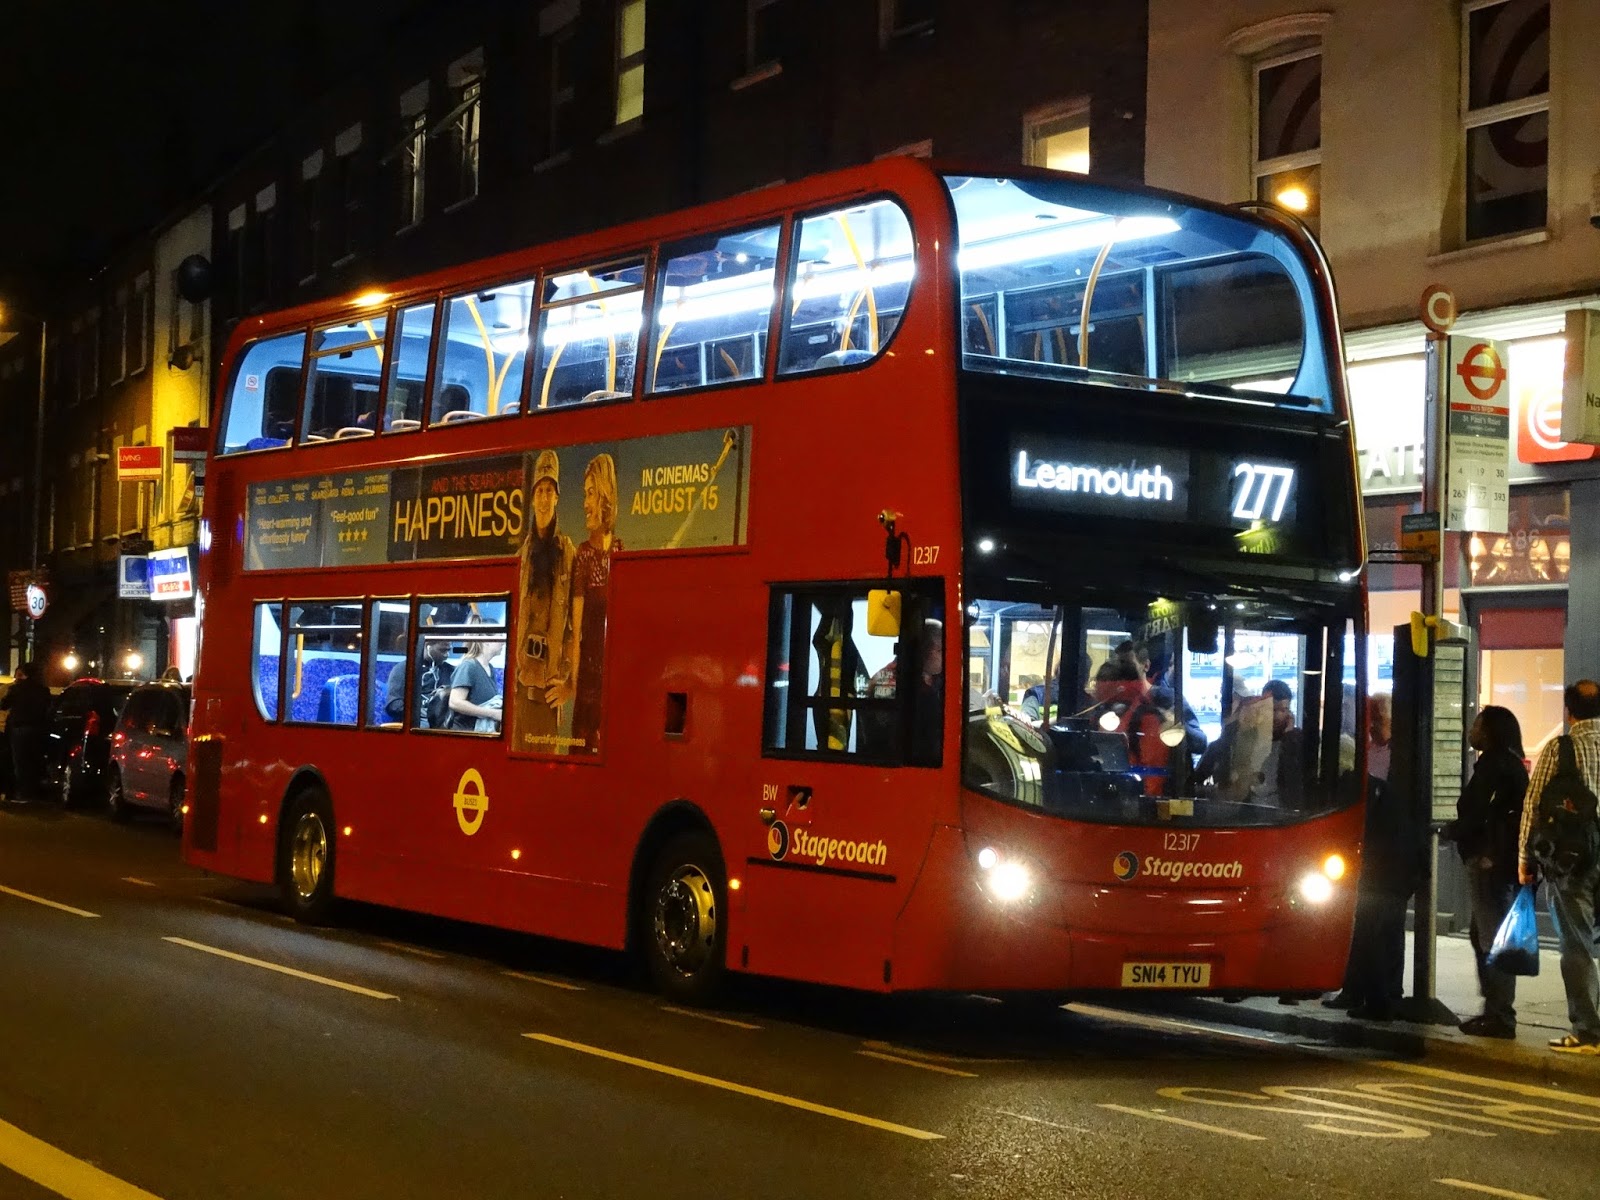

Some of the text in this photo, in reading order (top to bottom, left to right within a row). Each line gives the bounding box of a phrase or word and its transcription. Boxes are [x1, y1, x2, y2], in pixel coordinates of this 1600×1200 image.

[1428, 291, 1451, 326] C
[642, 463, 709, 487] IN CINEMAS
[1018, 450, 1173, 501] Leamouth
[1495, 469, 1505, 478] 30
[631, 485, 719, 515] AUGUST 15
[1232, 463, 1294, 522] 277
[1494, 492, 1506, 502] 393
[394, 488, 524, 542] HAPPINESS
[913, 545, 940, 565] 12317
[31, 597, 45, 610] 30
[763, 784, 779, 801] BW
[791, 828, 887, 866] Stagecoach
[1163, 833, 1200, 852] 12317
[1142, 856, 1243, 882] Stagecoach
[1131, 965, 1202, 983] SN14 TYU
